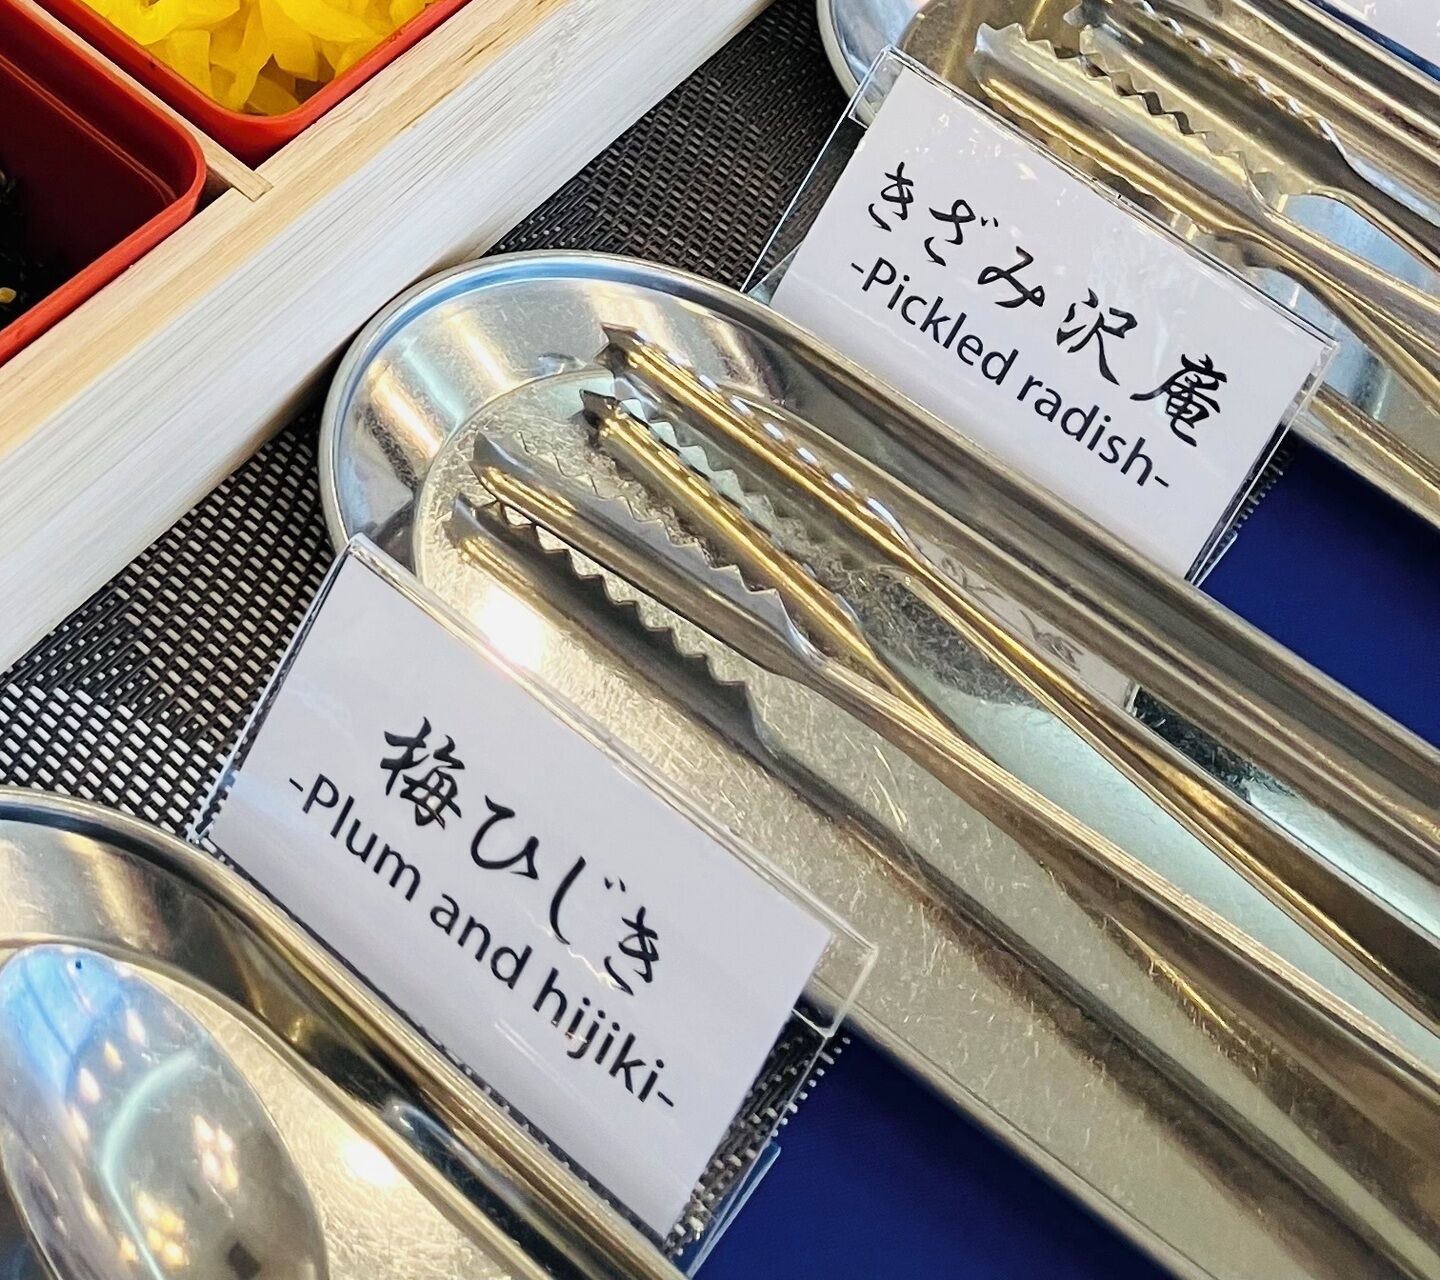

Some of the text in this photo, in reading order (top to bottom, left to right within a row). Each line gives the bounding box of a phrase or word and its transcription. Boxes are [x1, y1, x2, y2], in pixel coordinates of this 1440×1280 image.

[849, 255, 1171, 491] -Pickled radish-
[865, 161, 1229, 449] きざみ沢庵
[288, 772, 676, 1110] -Plum and hijiki-
[378, 715, 661, 997] 梅ひじき
